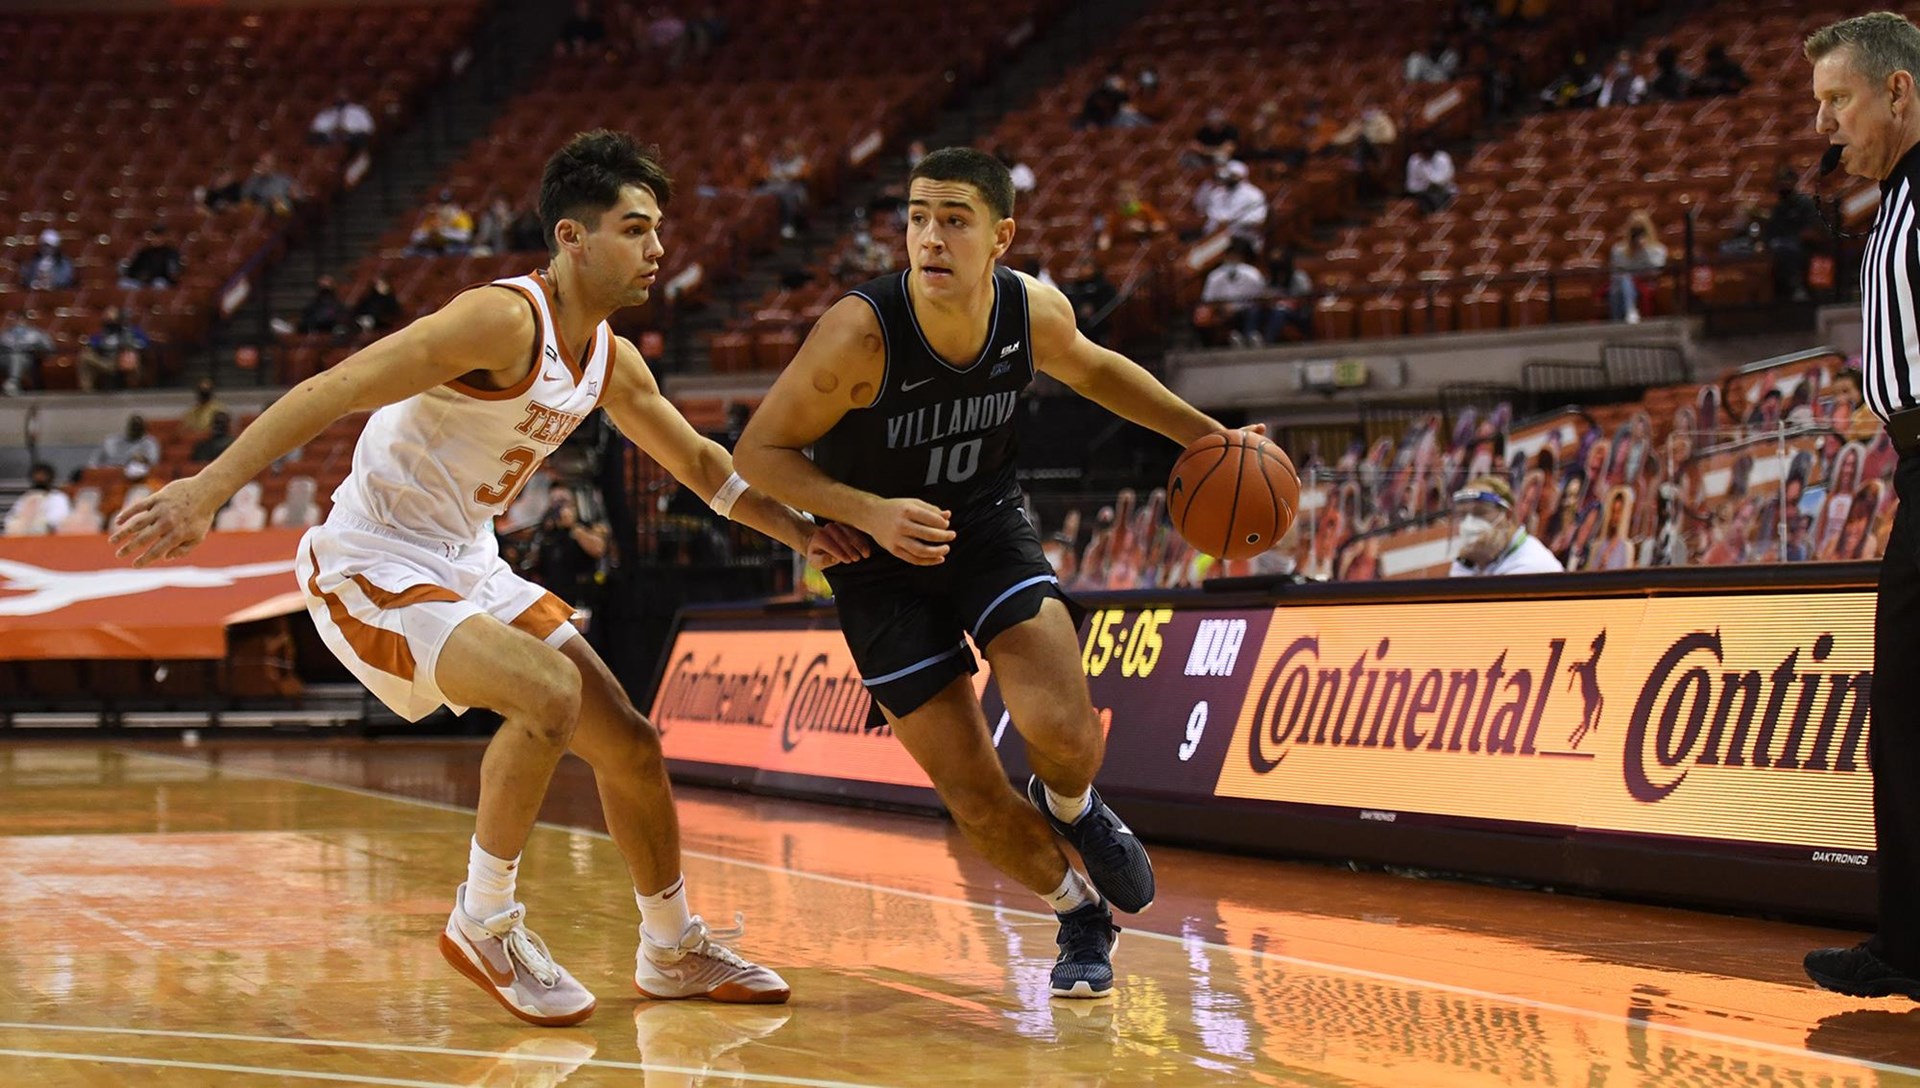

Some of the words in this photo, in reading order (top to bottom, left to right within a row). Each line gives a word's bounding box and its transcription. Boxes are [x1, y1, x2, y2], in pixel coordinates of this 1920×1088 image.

[514, 400, 584, 446] TEXA
[887, 390, 1017, 449] VILLANOVA
[474, 446, 543, 507] 3
[924, 438, 983, 486] 10
[1082, 609, 1173, 678] 15:05
[1184, 619, 1247, 676] NOVA
[782, 653, 892, 752] Contin
[1178, 701, 1208, 761] 9
[1249, 633, 1567, 774] Continental
[1623, 625, 1873, 804] Contin
[1812, 851, 1869, 865] DAKTRONICS
